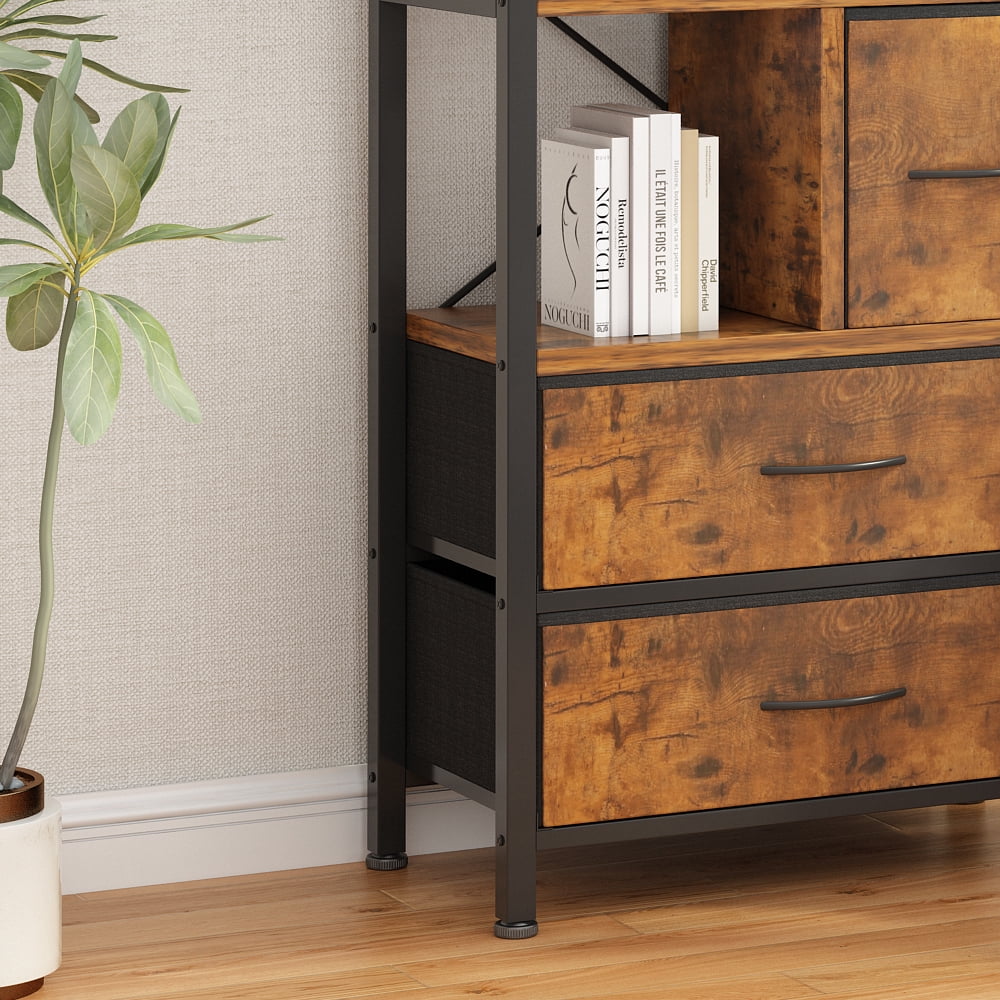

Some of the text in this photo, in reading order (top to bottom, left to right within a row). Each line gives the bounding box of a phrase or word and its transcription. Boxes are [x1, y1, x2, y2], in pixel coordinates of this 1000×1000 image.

[596, 187, 610, 291] NOGUCHI
[618, 199, 628, 269] Remodelista
[656, 169, 668, 294] IL ÉTAIT UNE FOIS LE CAFÉ
[700, 259, 709, 312] Chipperfield
[710, 259, 718, 283] David
[544, 304, 590, 332] NOGUCHI
